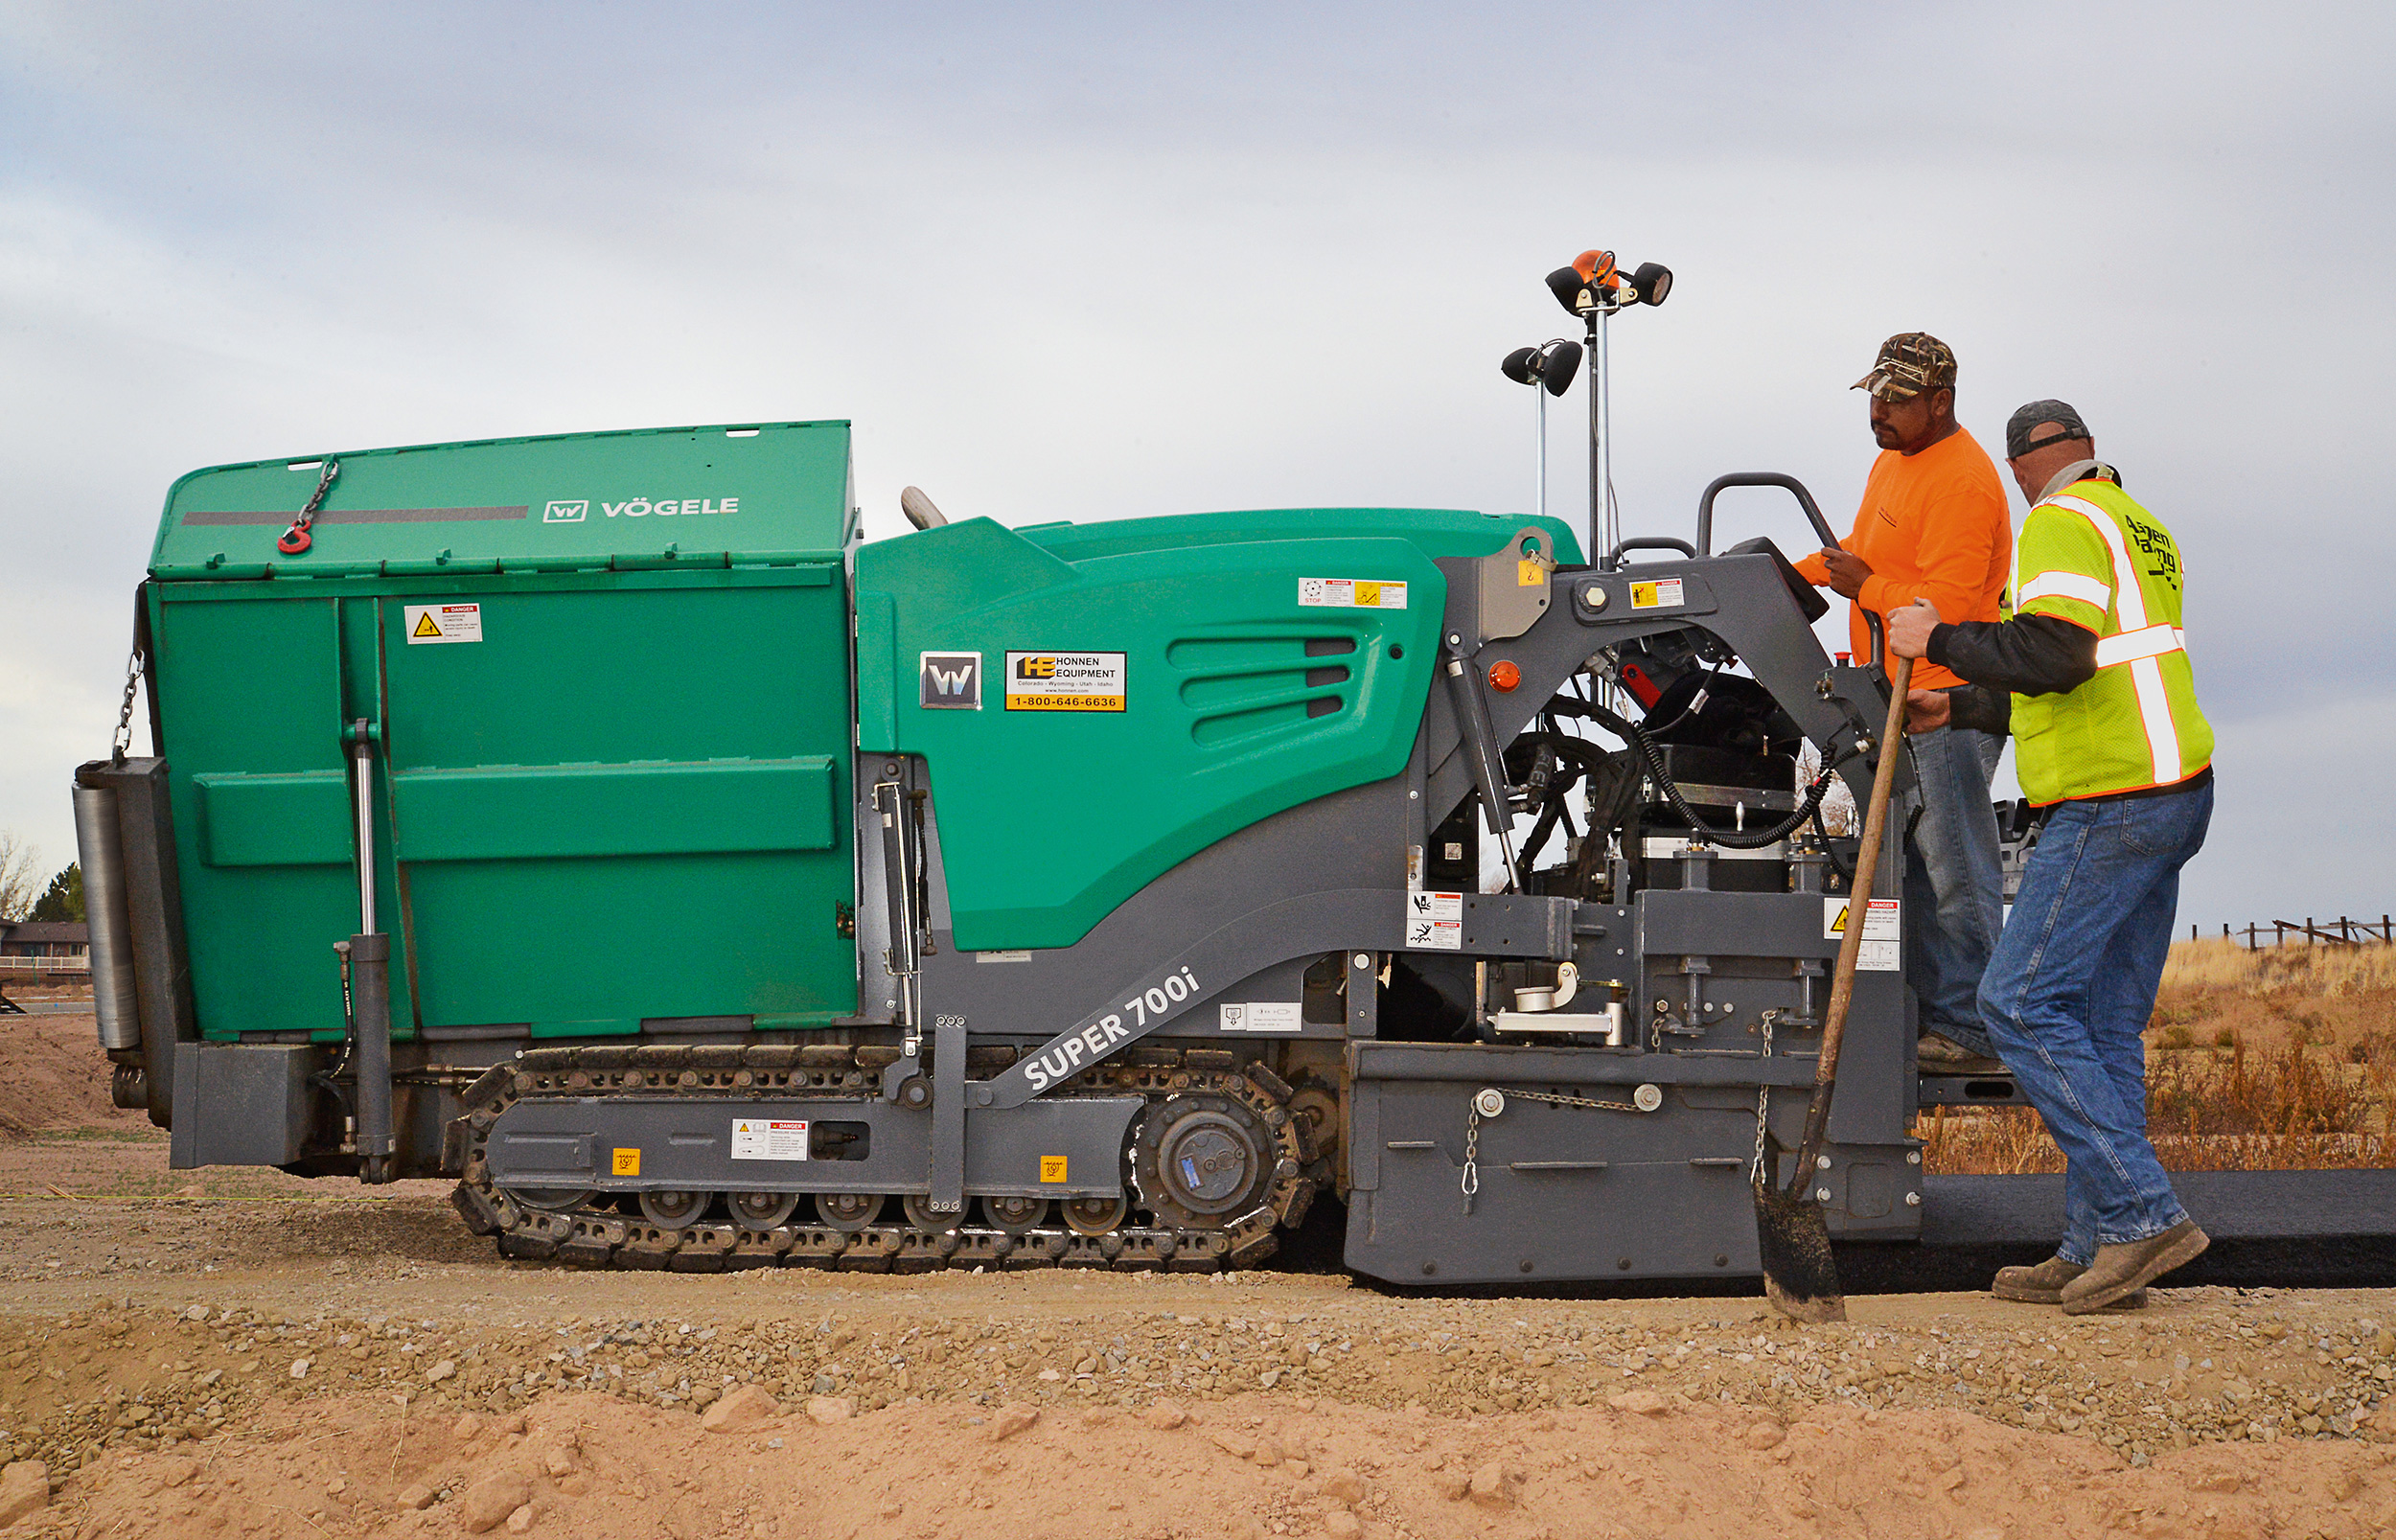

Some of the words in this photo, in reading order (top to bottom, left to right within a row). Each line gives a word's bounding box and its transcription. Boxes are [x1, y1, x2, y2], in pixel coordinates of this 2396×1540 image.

[601, 497, 739, 517] VÖGELE
[1056, 657, 1099, 666] HONNEN
[1056, 670, 1116, 678] EQUIPMENT
[1015, 697, 1117, 707] 1-800-646-6636
[1024, 1014, 1130, 1091] SUPER
[1124, 965, 1200, 1027] 700i
